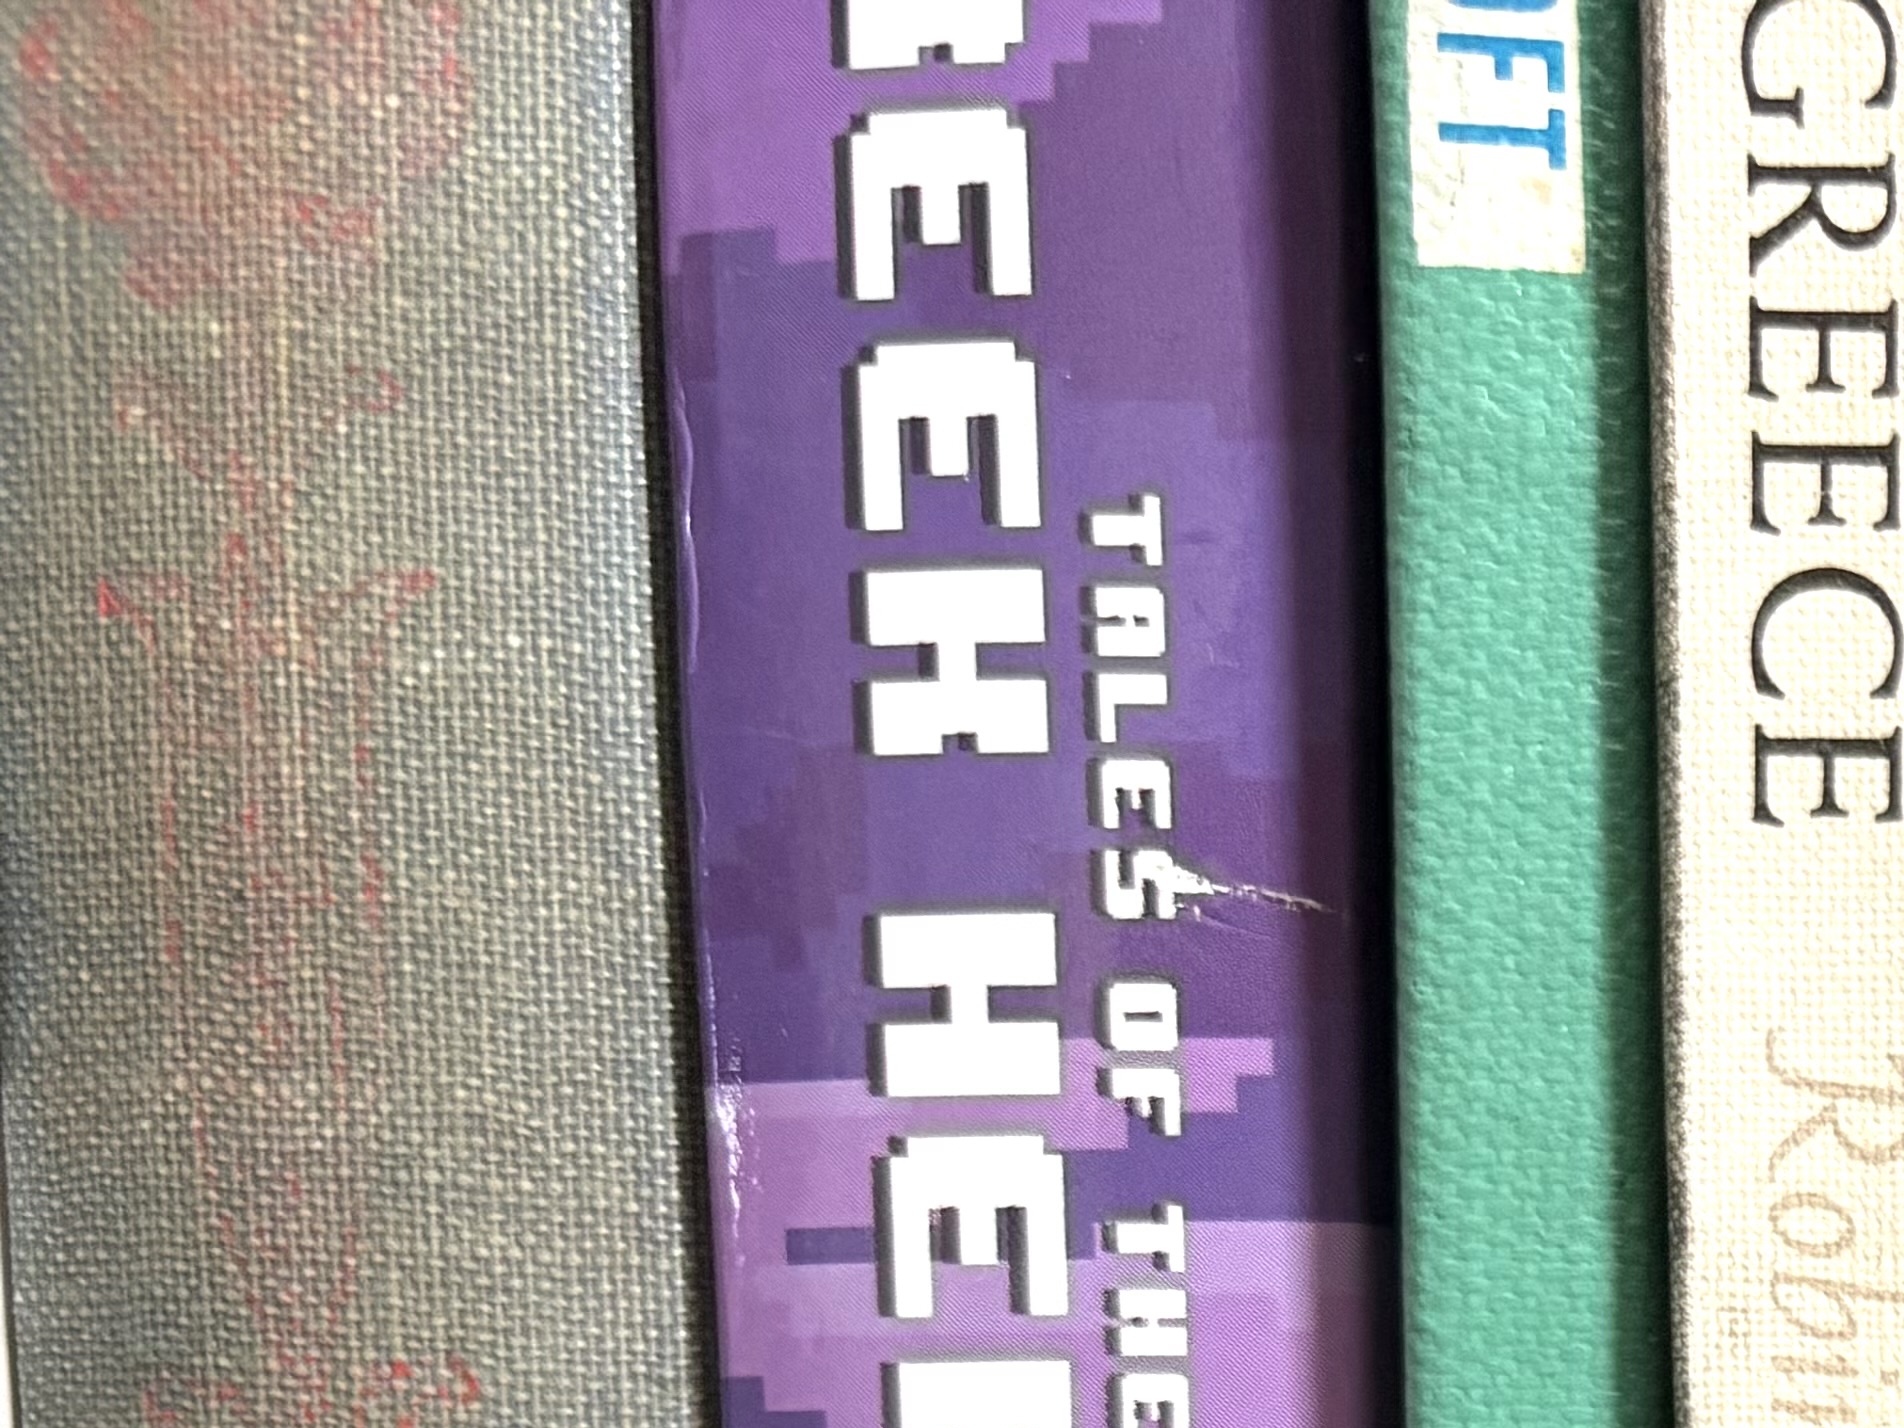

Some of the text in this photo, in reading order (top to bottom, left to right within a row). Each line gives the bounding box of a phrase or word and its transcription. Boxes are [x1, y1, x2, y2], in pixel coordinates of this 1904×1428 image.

[1436, 0, 1568, 170] FT
[1741, 0, 1904, 828] GREECE
[1084, 493, 1177, 920] TALES
[1096, 979, 1184, 1137] OF
